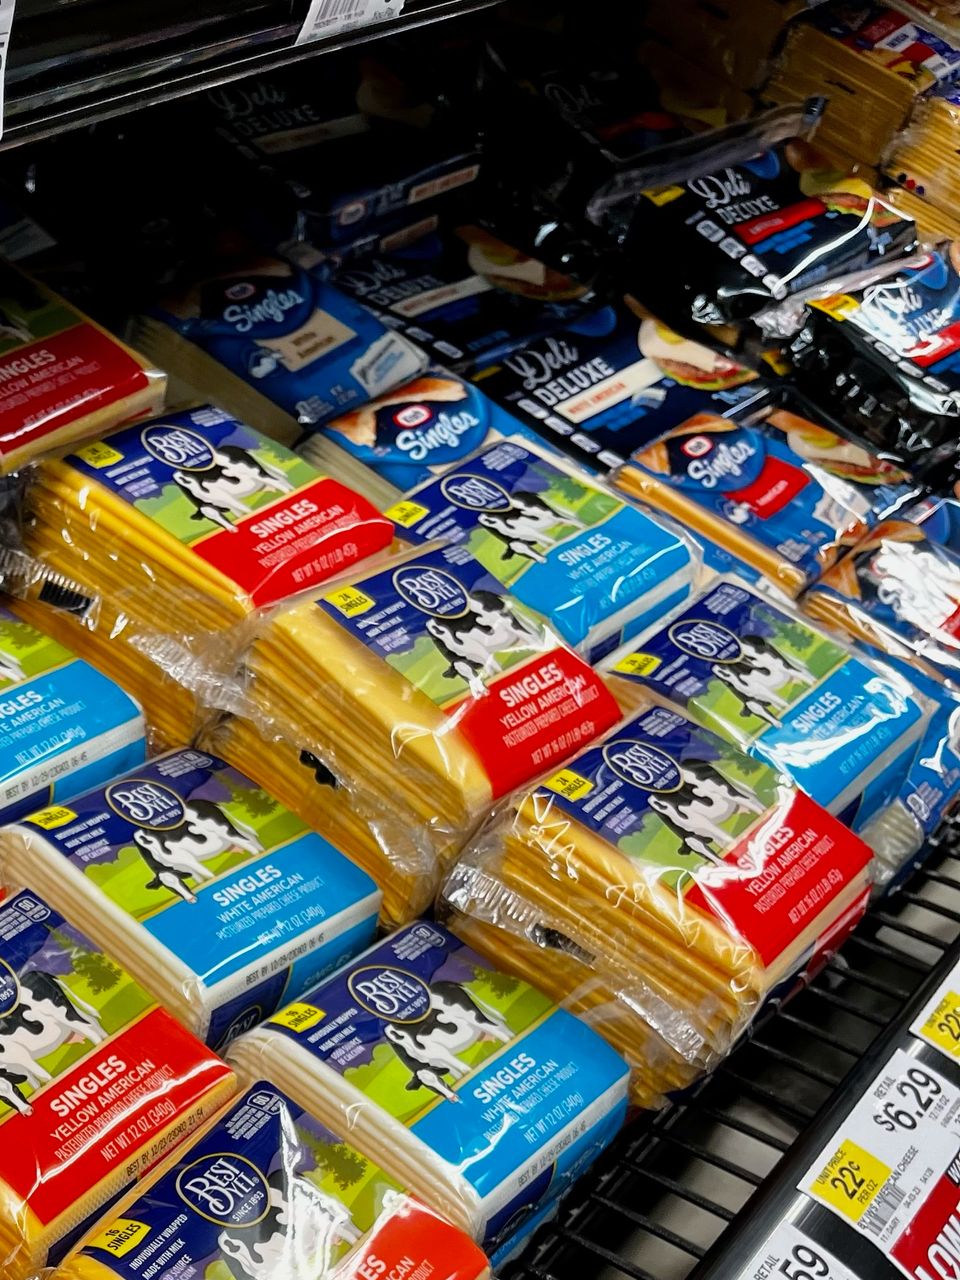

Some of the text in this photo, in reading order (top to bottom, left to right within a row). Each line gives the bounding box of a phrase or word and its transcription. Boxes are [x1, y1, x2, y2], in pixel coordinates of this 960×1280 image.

[717, 195, 781, 225] DELUXE
[223, 287, 304, 332] Singles
[533, 357, 616, 406] DELUXE
[395, 406, 481, 461] Singles
[688, 439, 756, 488] Singles
[251, 499, 319, 540] SINGLES
[252, 504, 345, 555] YELLOW AMERICAN
[557, 533, 612, 565] SINGLES
[499, 662, 563, 709] SINGLES
[791, 691, 842, 734] SINGLES
[212, 864, 281, 908] SINGLES
[217, 872, 304, 925] WHITE AMERICAN
[49, 1053, 127, 1118] SINGLES
[49, 1057, 157, 1142] YELLOW AMERICAN
[473, 1052, 536, 1105] SINGLES
[873, 1075, 897, 1101] RETAIL
[873, 1067, 942, 1133] $6.29
[815, 1147, 848, 1186] UNIT PRICE
[232, 1191, 265, 1222] SINCE 1893
[856, 1179, 880, 1205] PER OZ
[105, 1228, 120, 1238] 16
[107, 1223, 141, 1251] SINGLES
[141, 1238, 186, 1280] MADE WITH MILK
